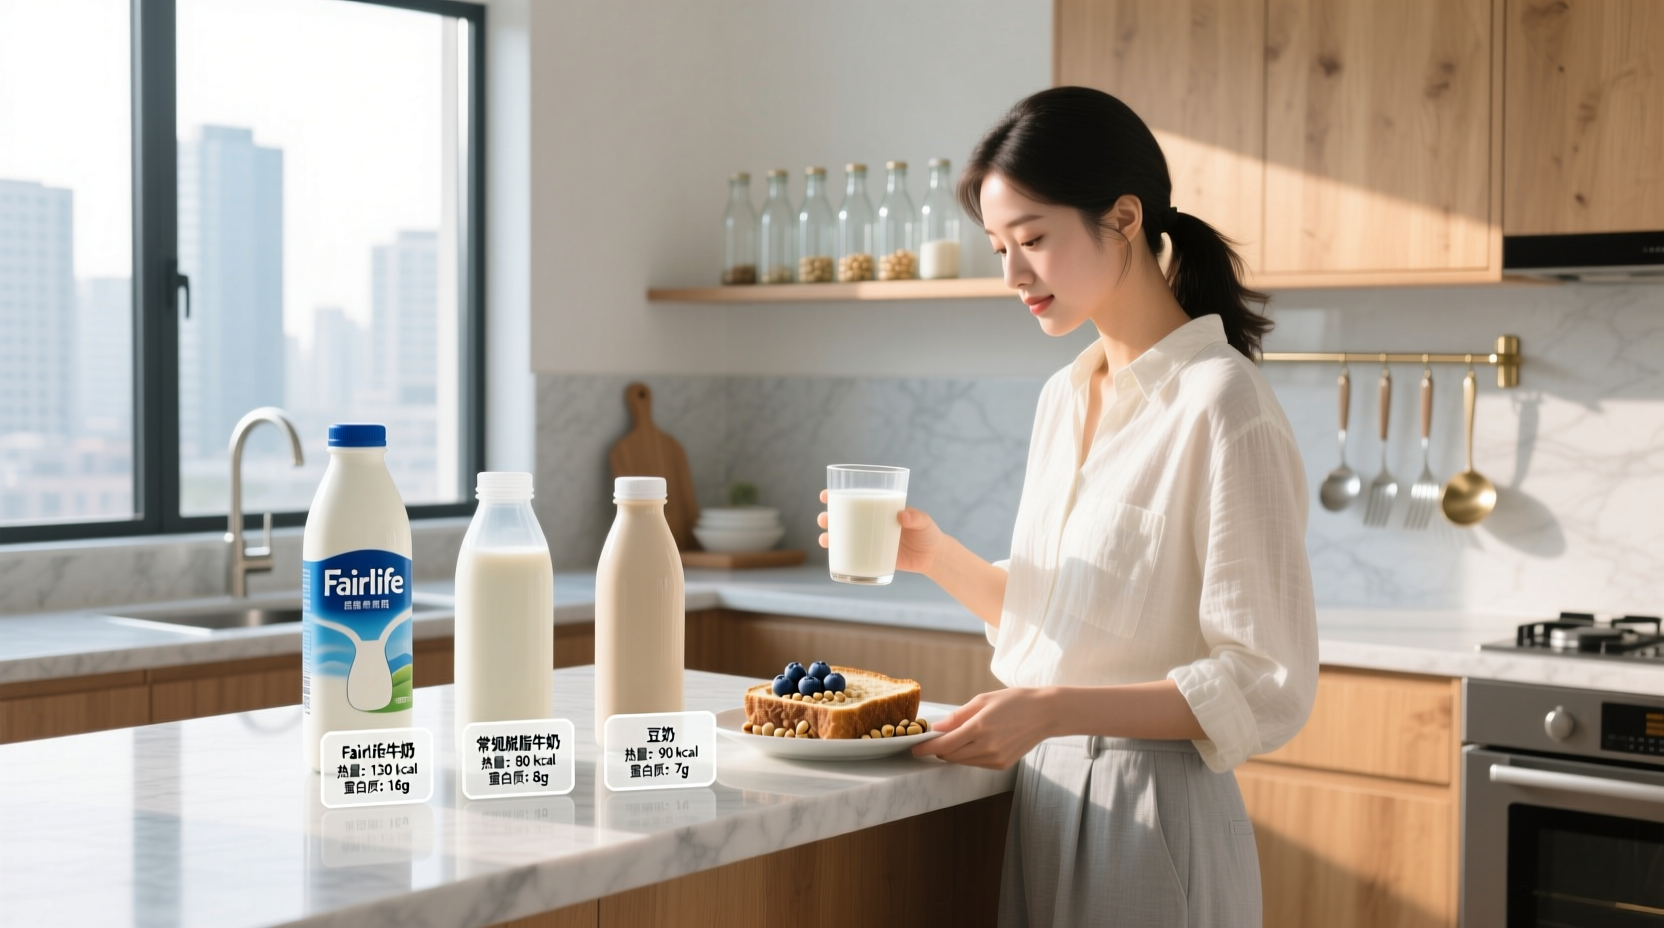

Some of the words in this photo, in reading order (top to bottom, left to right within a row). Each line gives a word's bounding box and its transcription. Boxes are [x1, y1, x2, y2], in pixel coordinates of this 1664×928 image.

[324, 567, 404, 596] Fairlife
[647, 726, 675, 743] 豆奶
[515, 755, 530, 767] 80
[534, 753, 556, 766] kcal
[659, 747, 673, 759] 90
[676, 745, 698, 758] kcal
[533, 770, 549, 786] 8g
[675, 762, 689, 778] 7g
[388, 779, 410, 794] 16g
